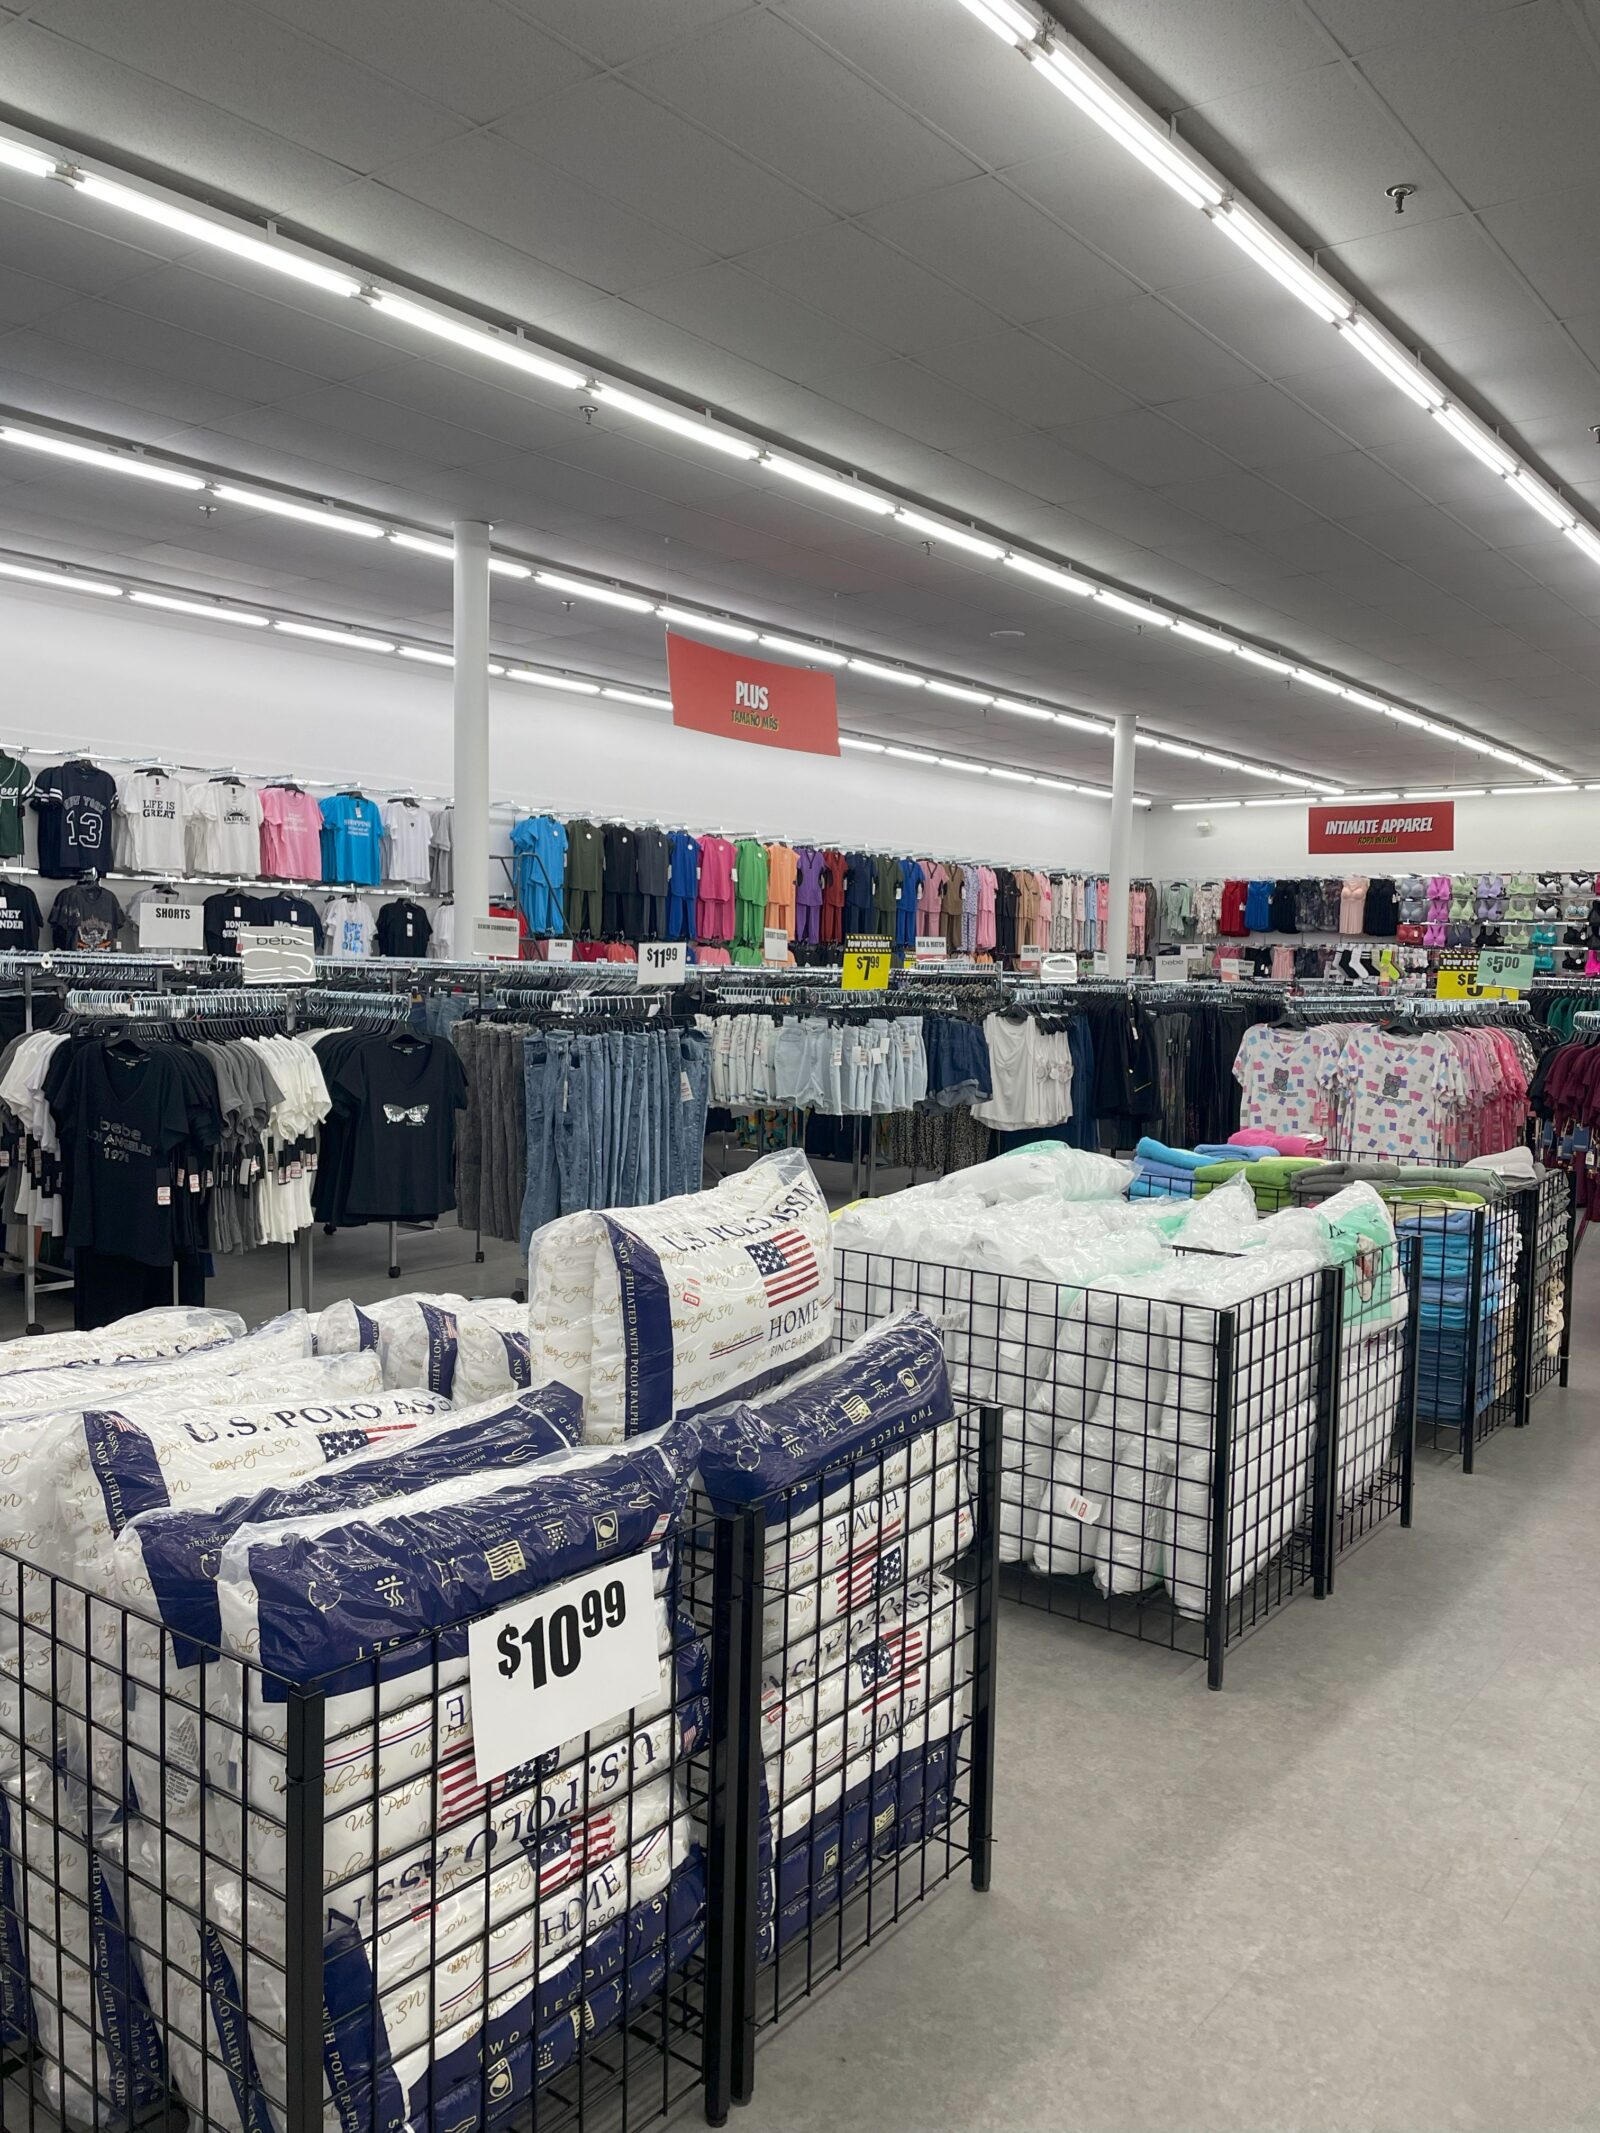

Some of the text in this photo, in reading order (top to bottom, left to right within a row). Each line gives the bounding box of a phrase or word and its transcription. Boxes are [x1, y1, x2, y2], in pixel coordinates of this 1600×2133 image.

[735, 680, 769, 711] PLUS
[142, 809, 176, 820] GREAT
[143, 799, 176, 811] LIFE IS
[66, 809, 103, 849] 13
[1325, 816, 1433, 835] INTIMATE APPAREL
[155, 907, 191, 920] SHORTS
[646, 947, 678, 969] $1199
[847, 939, 890, 949] low price alert
[856, 955, 880, 981] $799
[1161, 958, 1185, 967] bebe
[1443, 958, 1480, 968] low pri
[1486, 955, 1520, 973] $500
[616, 1241, 631, 1266] NOT
[622, 1266, 638, 1325] AFFILIATED
[767, 1297, 820, 1342] HOME
[628, 1326, 639, 1356] WITH
[431, 1338, 442, 1392] NOT AFFILI
[512, 1358, 523, 1381] NOT
[630, 1357, 640, 1390] POLO
[181, 1416, 271, 1445] U.S.
[272, 1403, 383, 1429] POLO
[629, 1391, 640, 1429] RALPH
[910, 1404, 934, 1424] TWO
[870, 1420, 906, 1448] PIECE
[94, 1441, 128, 1530] NOT AFFILIATE
[496, 1580, 627, 1690] $1099
[589, 1731, 657, 1793] U.S.
[97, 1932, 109, 1970] POLO
[222, 2019, 242, 2068] RALPH
[478, 2030, 520, 2064] TWO
